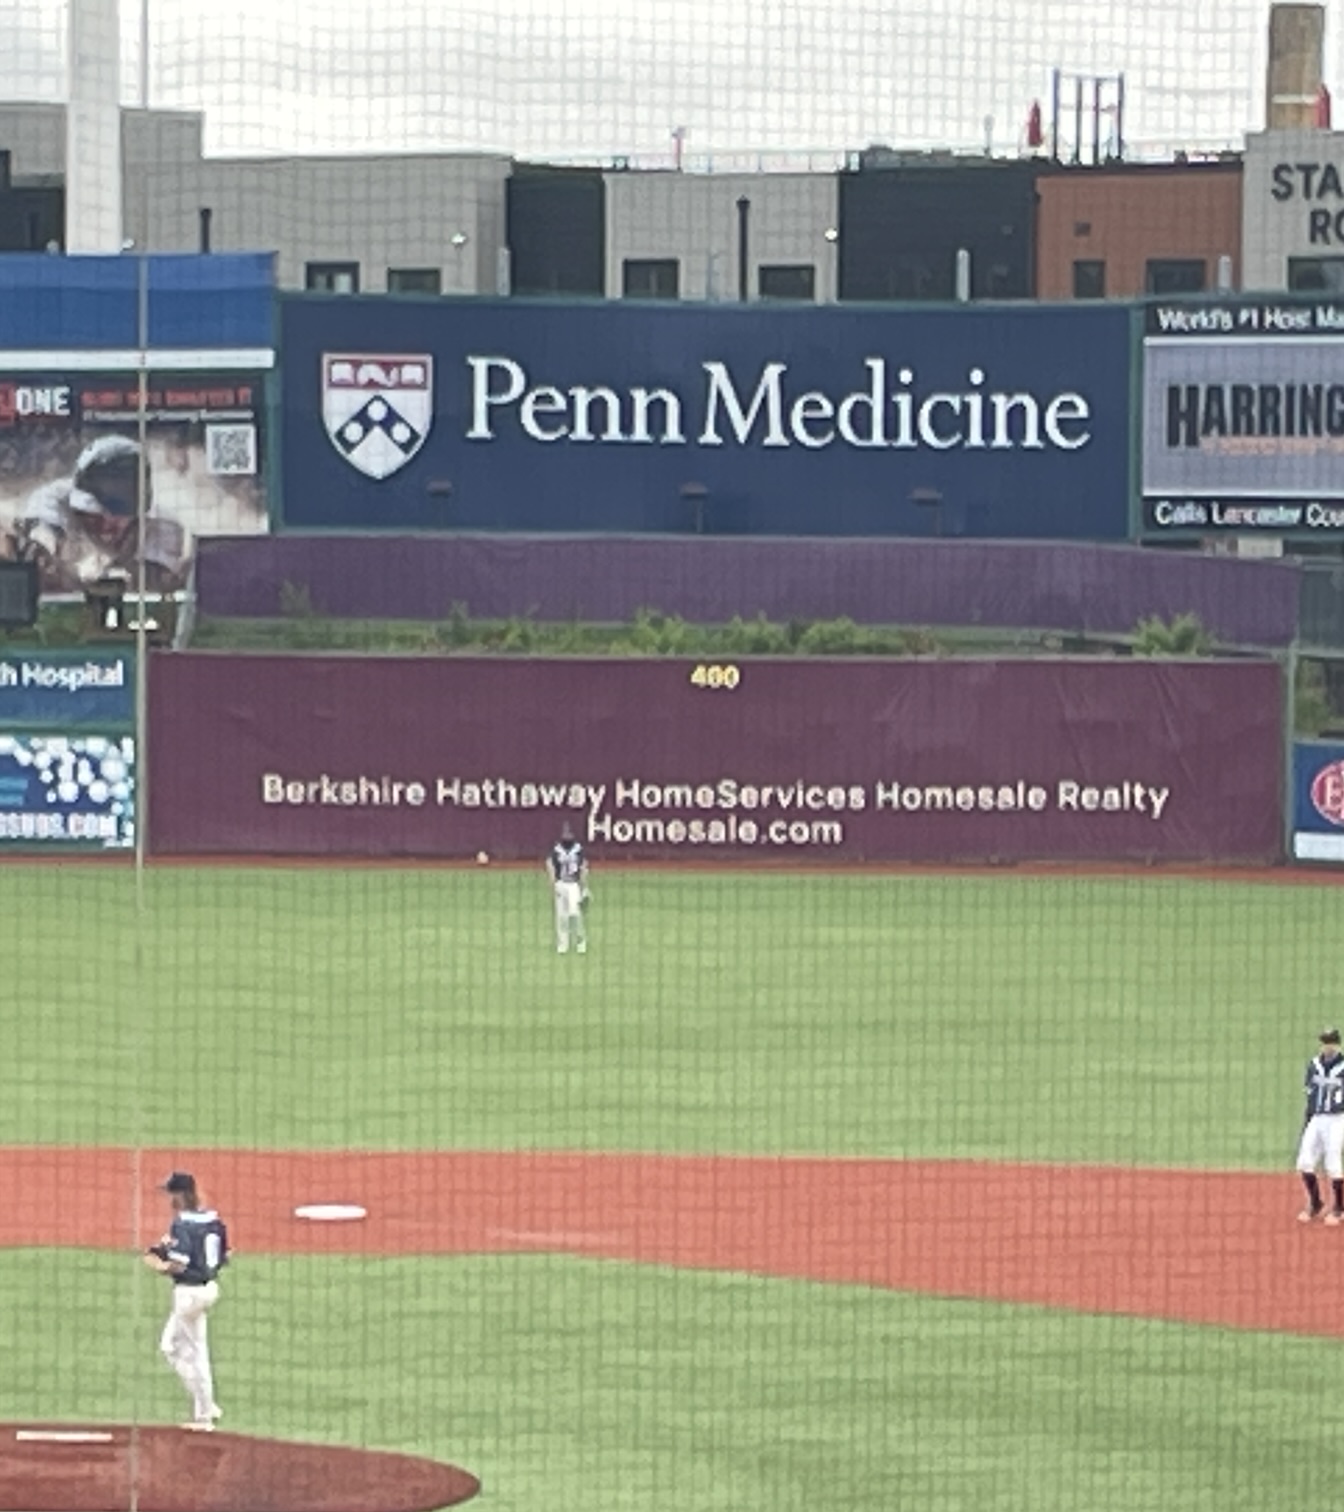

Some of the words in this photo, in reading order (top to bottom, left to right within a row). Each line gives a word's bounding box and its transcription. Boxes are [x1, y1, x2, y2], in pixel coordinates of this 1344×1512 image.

[465, 355, 686, 442] Penn
[698, 358, 1092, 450] Medicine
[22, 660, 124, 692] Hospital
[690, 665, 740, 689] 400
[262, 773, 427, 805] Berkshire
[435, 777, 606, 813] Hathaway
[616, 778, 866, 811] HomeServices
[876, 780, 1048, 812] Homesale
[1058, 780, 1170, 819] Realty
[588, 812, 844, 845] Homesale.com
